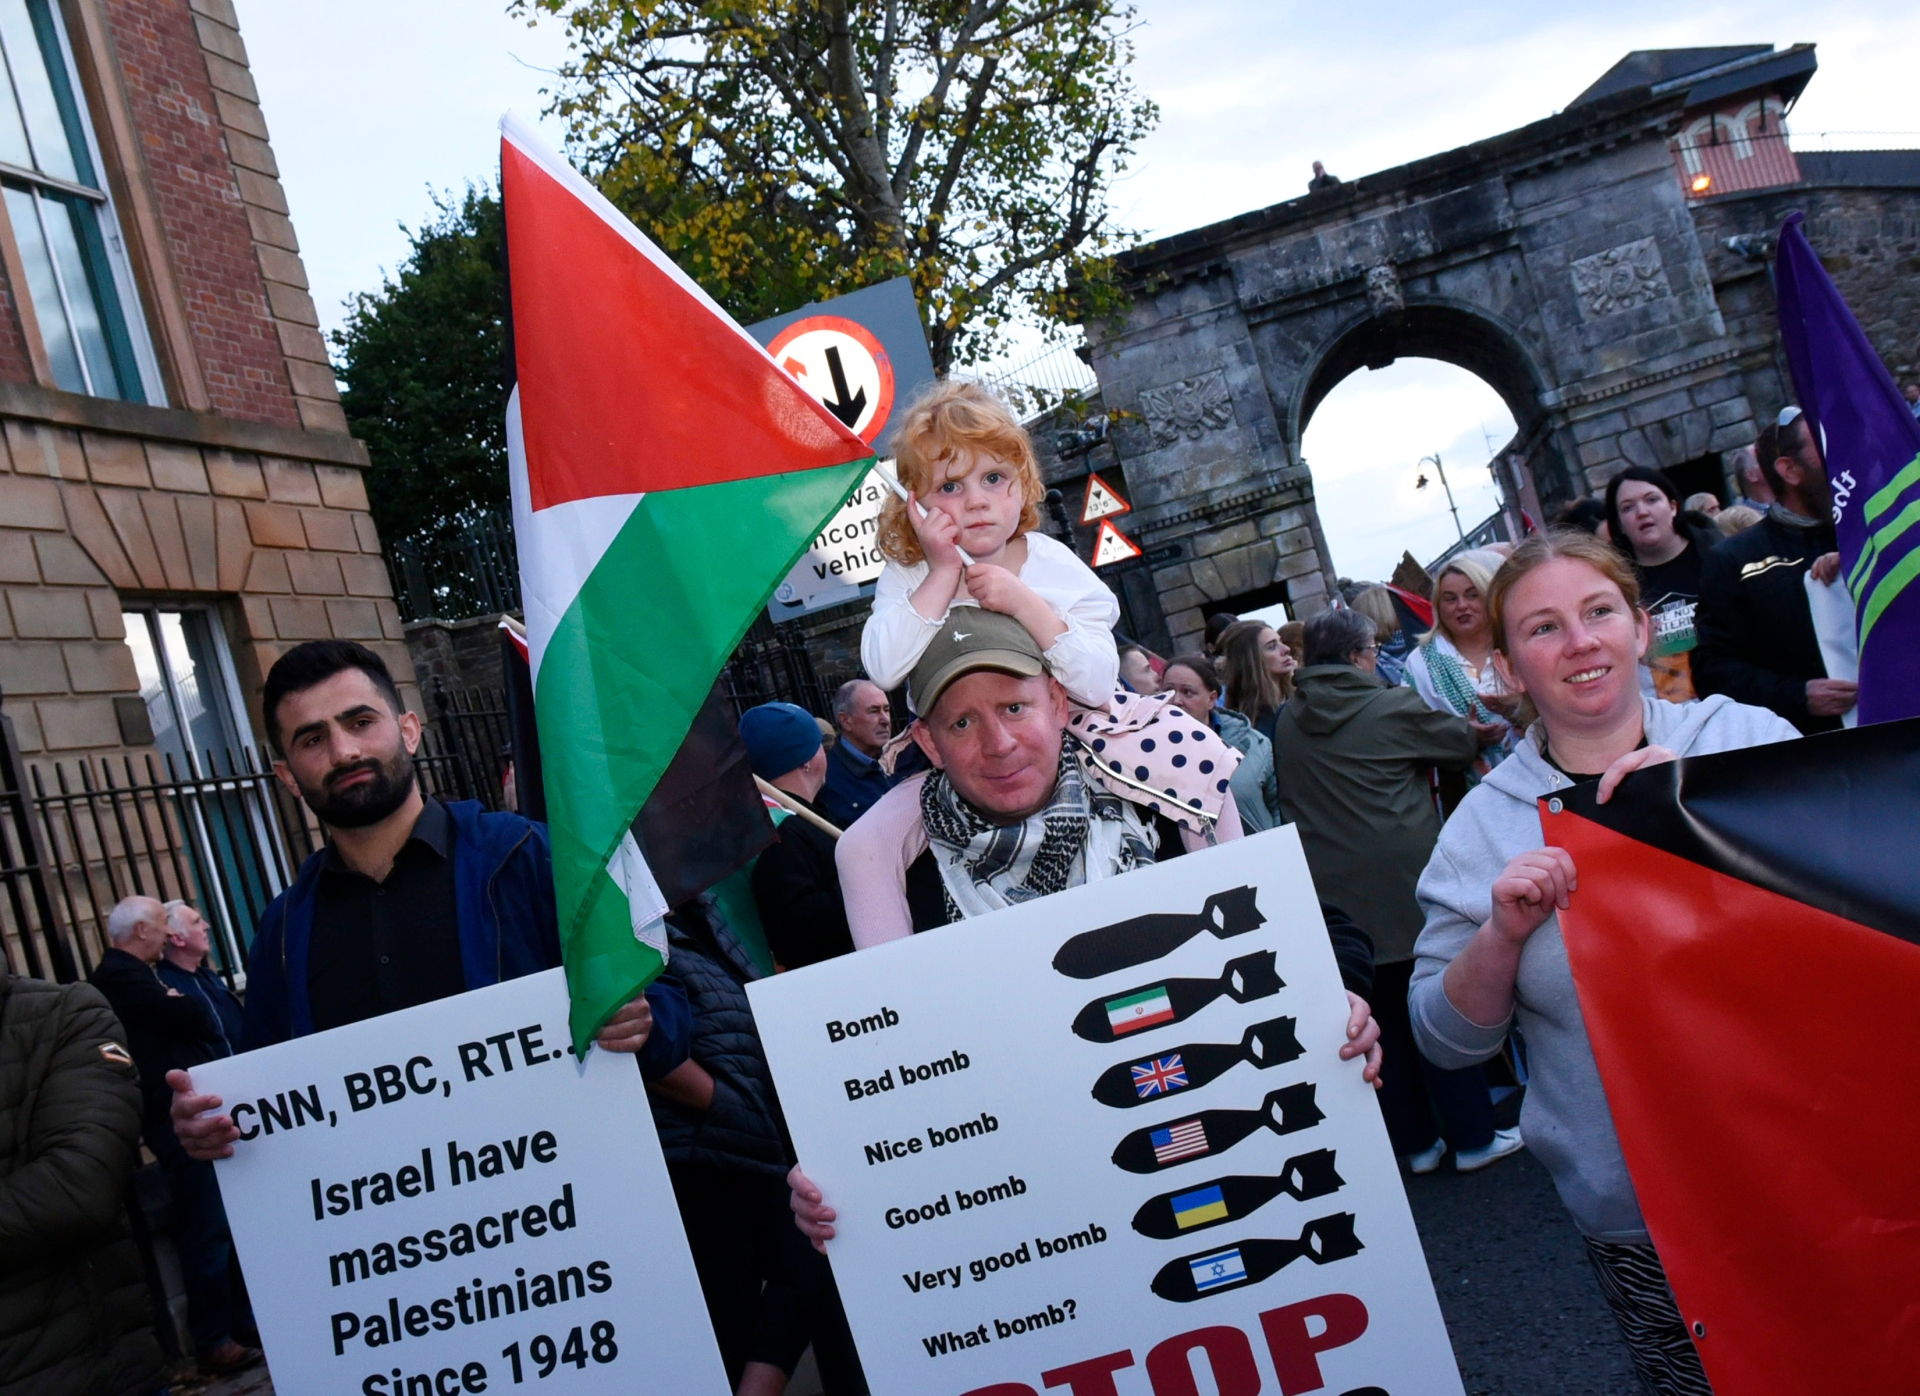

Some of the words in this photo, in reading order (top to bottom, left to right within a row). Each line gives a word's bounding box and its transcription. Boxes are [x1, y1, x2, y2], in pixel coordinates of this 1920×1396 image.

[806, 516, 878, 553] ncom
[812, 546, 884, 580] vehic
[825, 1007, 900, 1044] Bomb
[229, 1084, 338, 1141] CNN,
[343, 1055, 451, 1113] BBC,
[844, 1070, 895, 1102] Bad
[898, 1050, 971, 1086] bomb
[864, 1137, 923, 1166] Nice
[927, 1113, 999, 1149] bomb
[310, 1147, 436, 1222] Israel
[447, 1131, 558, 1187] have
[884, 1194, 952, 1230] Good
[955, 1175, 1027, 1211] bomb
[328, 1183, 577, 1287] massacred
[902, 1265, 962, 1294] Very
[968, 1241, 1032, 1283] good
[1034, 1222, 1108, 1259] bomb
[330, 1260, 613, 1357] Palestinians
[921, 1323, 991, 1358] What
[993, 1298, 1078, 1340] bomb?
[361, 1361, 488, 1396] Since
[501, 1319, 619, 1385] 1948
[956, 1293, 1369, 1396] TOP
